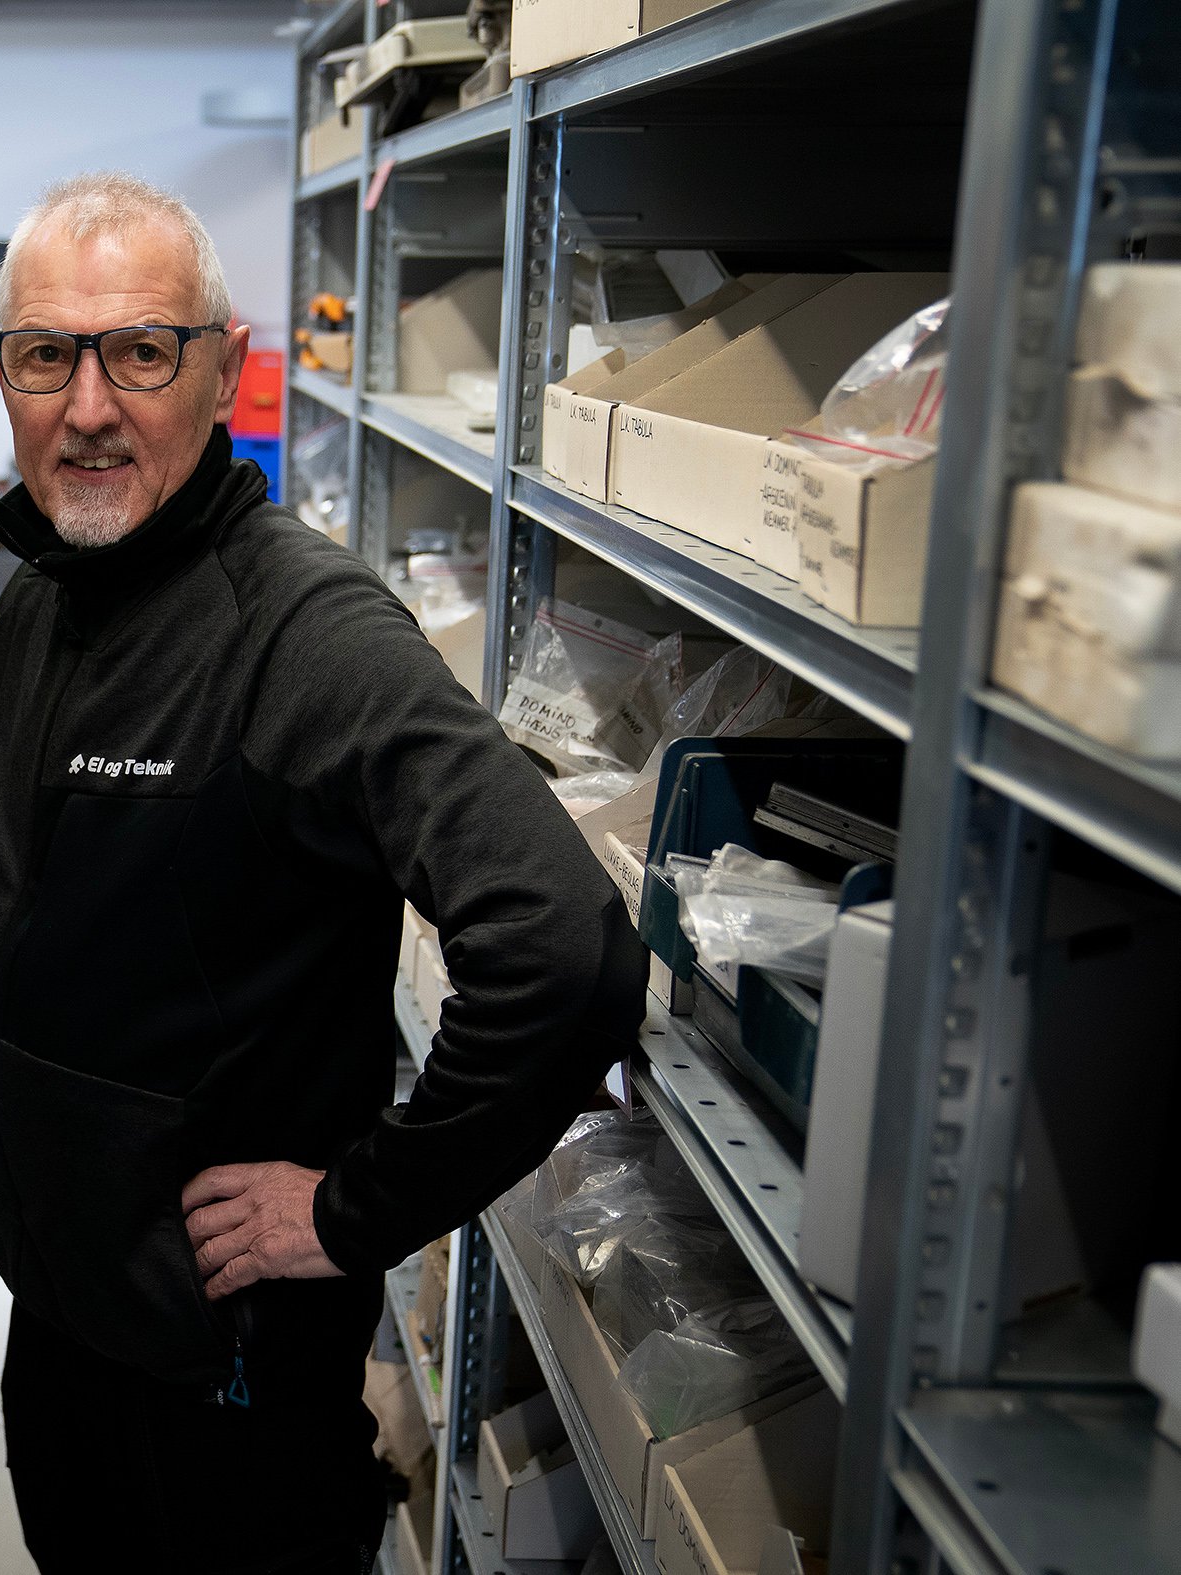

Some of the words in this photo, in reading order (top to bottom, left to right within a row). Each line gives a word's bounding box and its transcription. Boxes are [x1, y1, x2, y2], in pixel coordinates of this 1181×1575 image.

[579, 406, 596, 425] TABULA
[620, 411, 630, 433] LK
[631, 416, 653, 440] TABULA
[87, 756, 105, 773] El
[104, 761, 123, 778] og
[124, 758, 175, 776] Teknik
